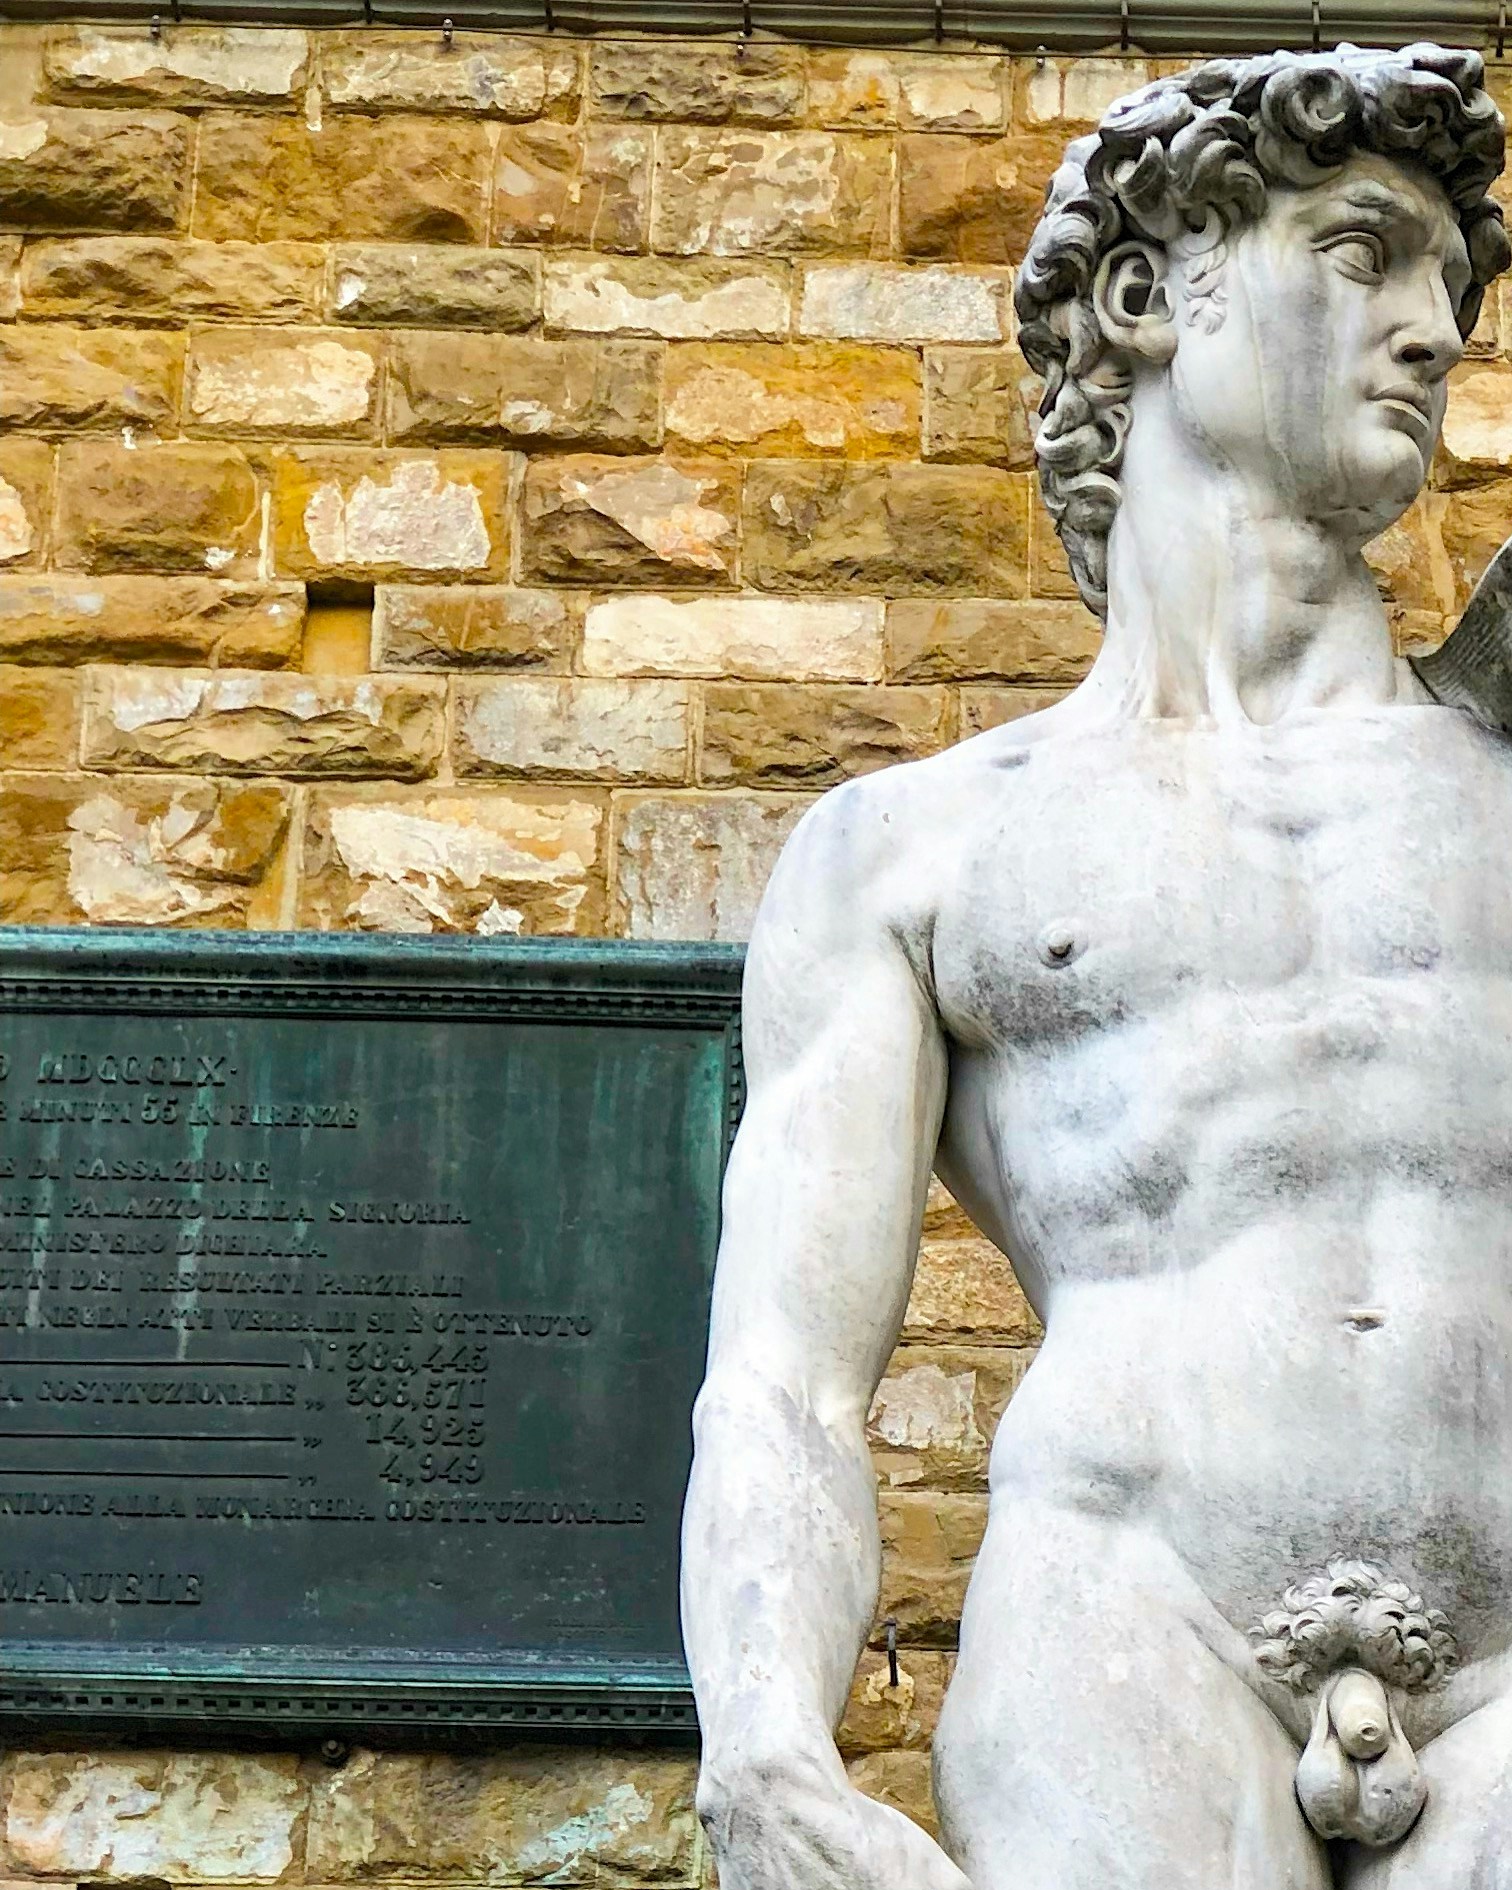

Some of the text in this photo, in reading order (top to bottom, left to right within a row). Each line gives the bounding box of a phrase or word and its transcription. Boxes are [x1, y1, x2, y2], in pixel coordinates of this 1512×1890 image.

[141, 1093, 177, 1124] 55
[231, 1104, 358, 1129] FIRENZE
[28, 1159, 60, 1181] DI
[74, 1159, 271, 1184] CASSAZIONE
[64, 1197, 201, 1220] PALAZZO
[212, 1200, 315, 1223] DELLA
[329, 1202, 471, 1225] SIGNORIA
[316, 1273, 463, 1298] PARZIALI
[138, 1307, 213, 1331] ATTI
[224, 1309, 355, 1334] VERBALI
[367, 1311, 396, 1335] SI
[431, 1311, 592, 1338] OTTENUTO
[37, 1381, 296, 1406] COSTITUZIONALE
[366, 1413, 486, 1449] 14,925
[379, 1452, 484, 1487] 4,949
[101, 1495, 186, 1520] ALLA
[196, 1497, 376, 1522] MONARCHIA
[386, 1499, 646, 1526] COSTITUZIONALE
